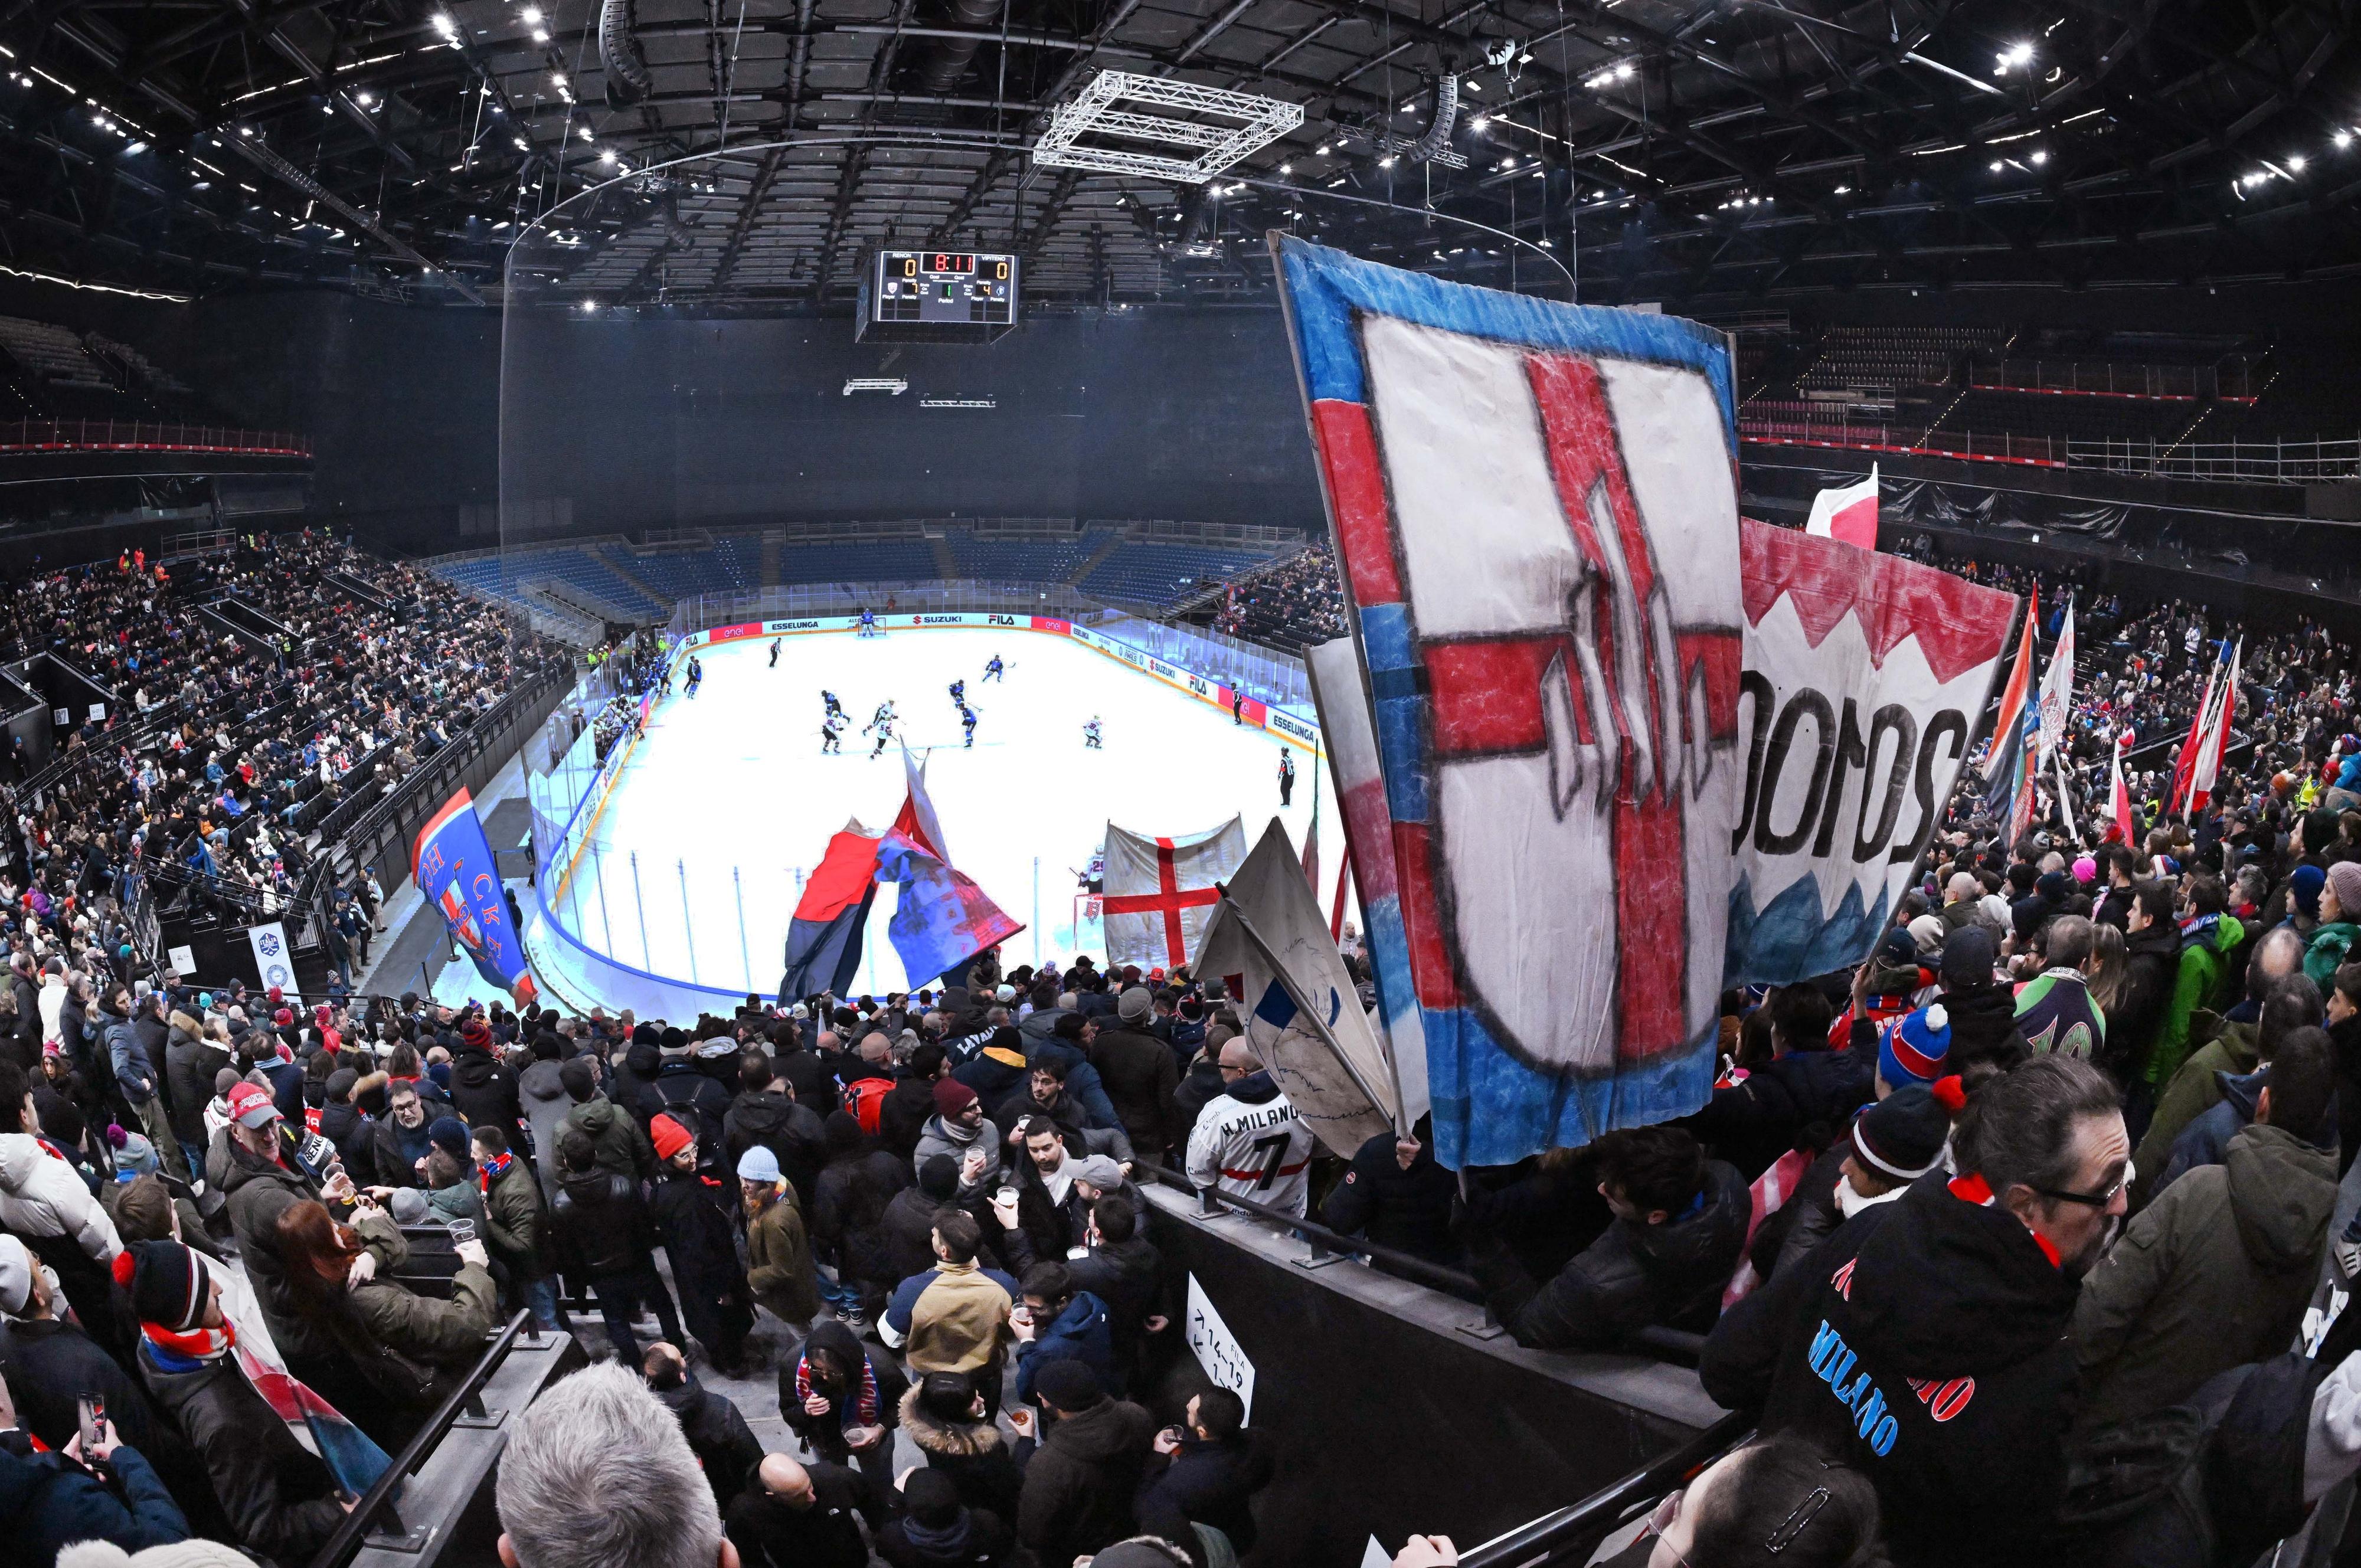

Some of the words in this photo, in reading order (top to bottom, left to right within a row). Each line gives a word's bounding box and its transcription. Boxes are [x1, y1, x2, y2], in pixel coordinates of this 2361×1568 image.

[905, 259, 916, 276] 0
[936, 254, 972, 271] 8:11
[996, 263, 1008, 279] 0
[912, 283, 918, 293] 7
[947, 284, 951, 296] 1
[983, 286, 990, 295] 4
[772, 621, 819, 630] ESSELUNGA
[989, 615, 1014, 625] FILA
[1046, 621, 1061, 631] enel
[724, 627, 744, 637] enel
[686, 635, 698, 648] FILA
[1155, 663, 1175, 679] SUZUKI
[1190, 675, 1206, 695] FILA
[1274, 715, 1314, 742] ESSELUNGA
[260, 937, 277, 945] ITALIA
[1254, 1132, 1291, 1191] 7
[1231, 1344, 1245, 1371] FILA
[1809, 1319, 1898, 1456] MILANO
